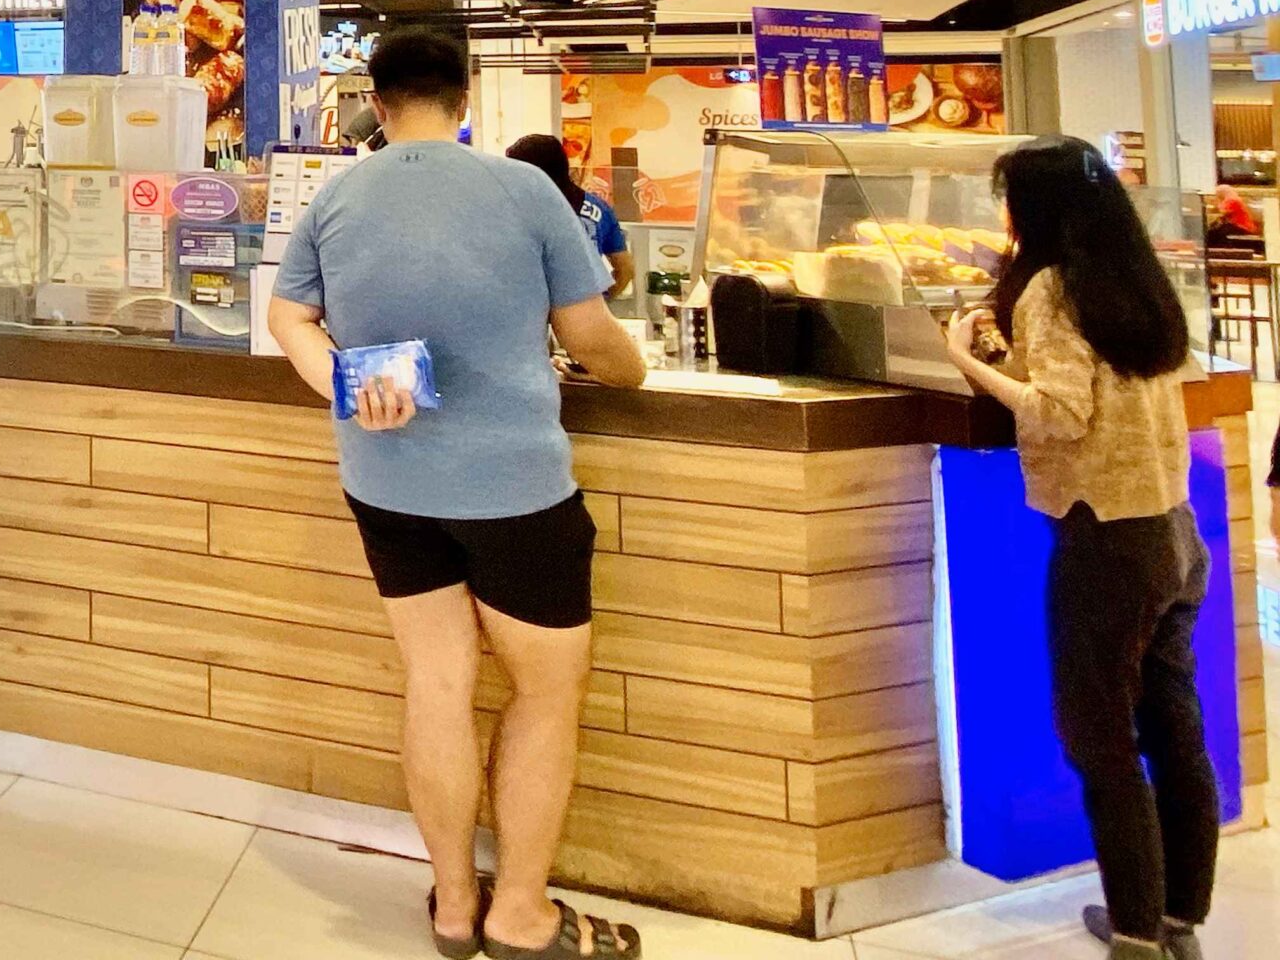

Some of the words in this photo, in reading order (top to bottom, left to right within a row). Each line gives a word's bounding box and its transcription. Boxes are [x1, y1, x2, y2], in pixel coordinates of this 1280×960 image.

[760, 25, 800, 37] JUMBO
[800, 27, 847, 39] SAUSAGE
[848, 29, 880, 41] SHOW
[699, 106, 759, 129] Spices
[580, 200, 602, 222] ED
